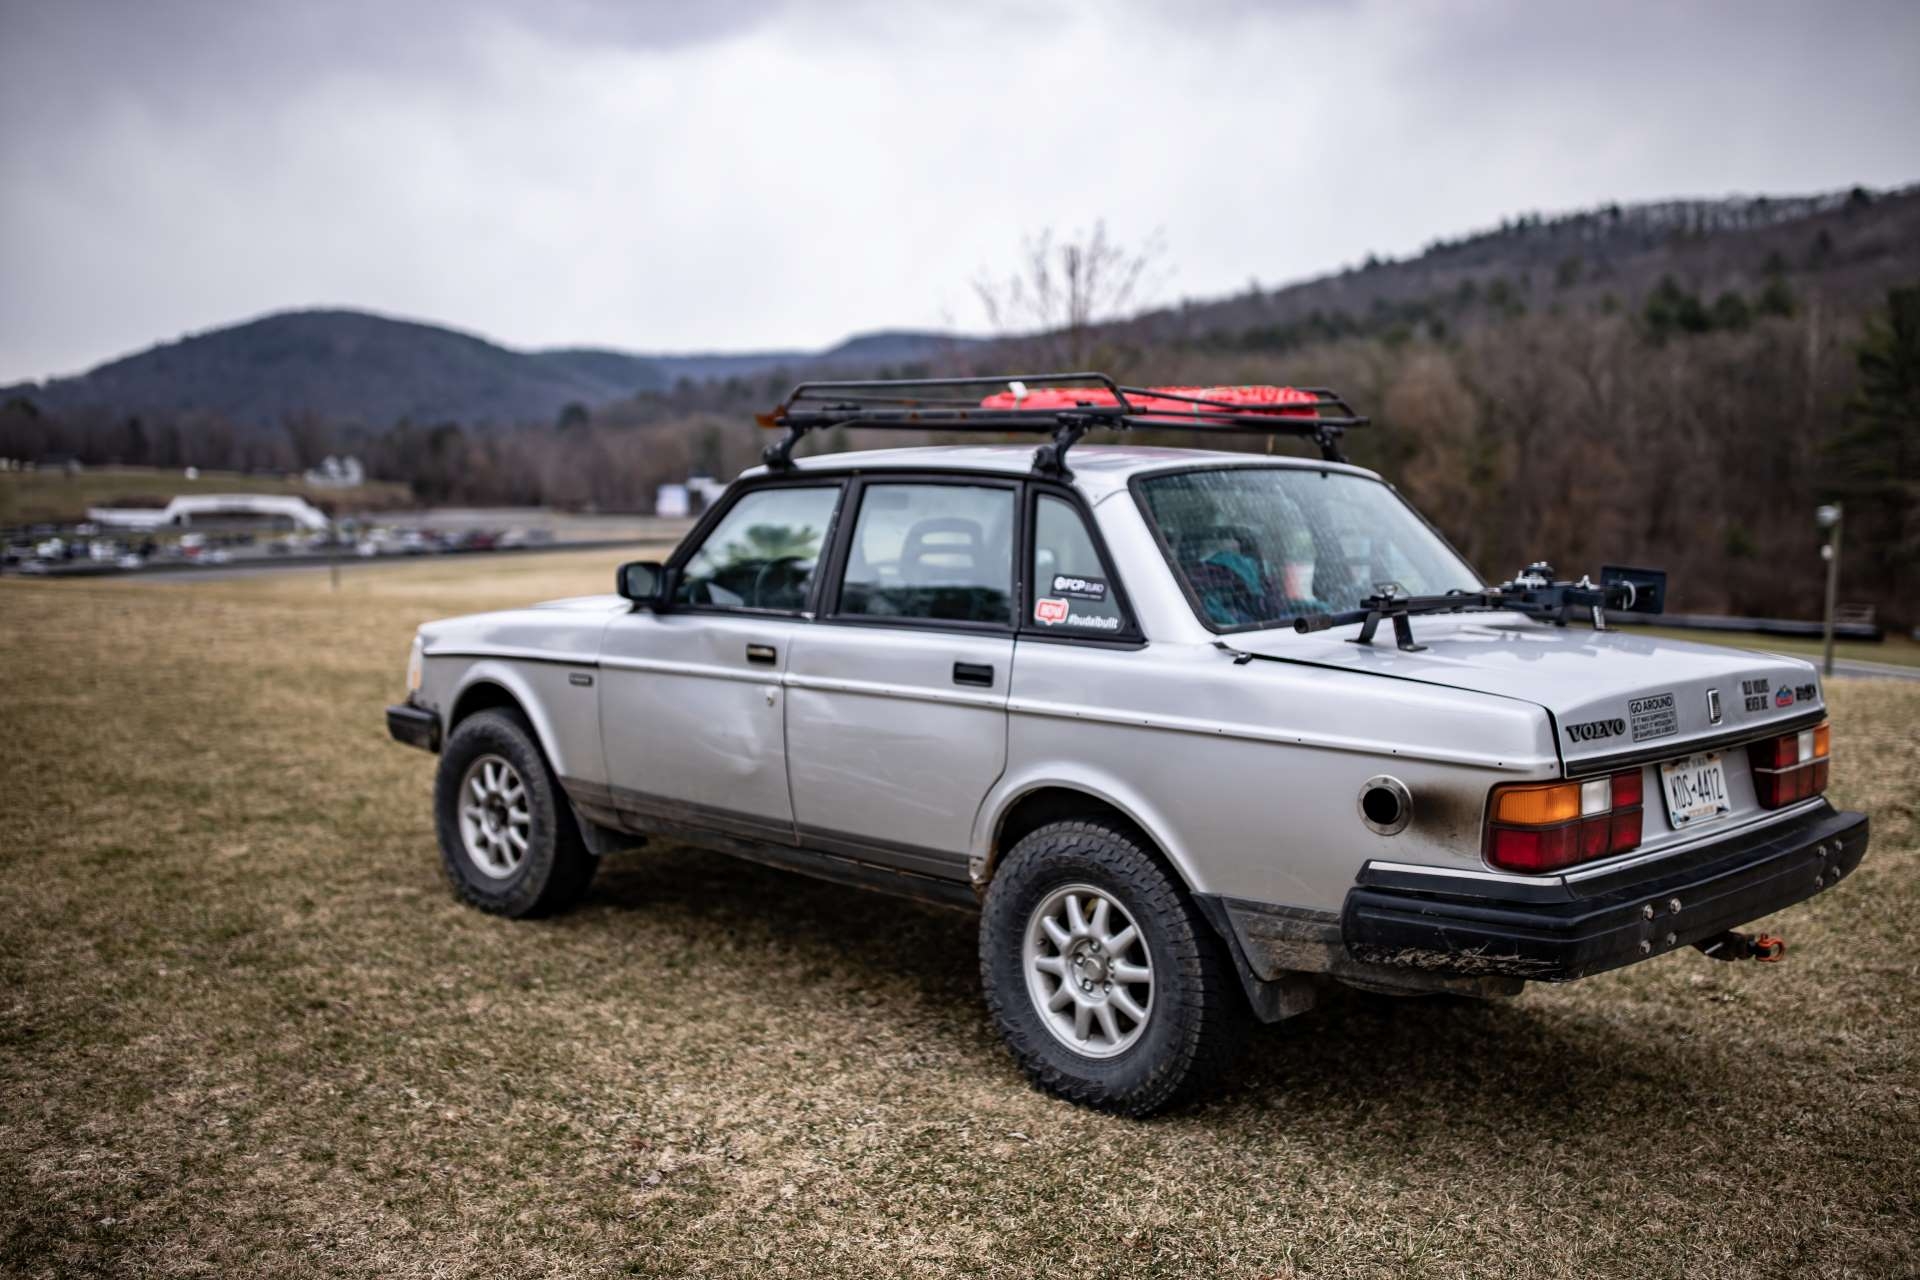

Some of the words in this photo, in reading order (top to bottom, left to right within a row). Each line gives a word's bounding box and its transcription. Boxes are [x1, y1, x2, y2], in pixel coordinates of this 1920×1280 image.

[1630, 702, 1642, 714] GO
[1643, 696, 1673, 712] AROUND
[1565, 718, 1626, 743] VOLVO
